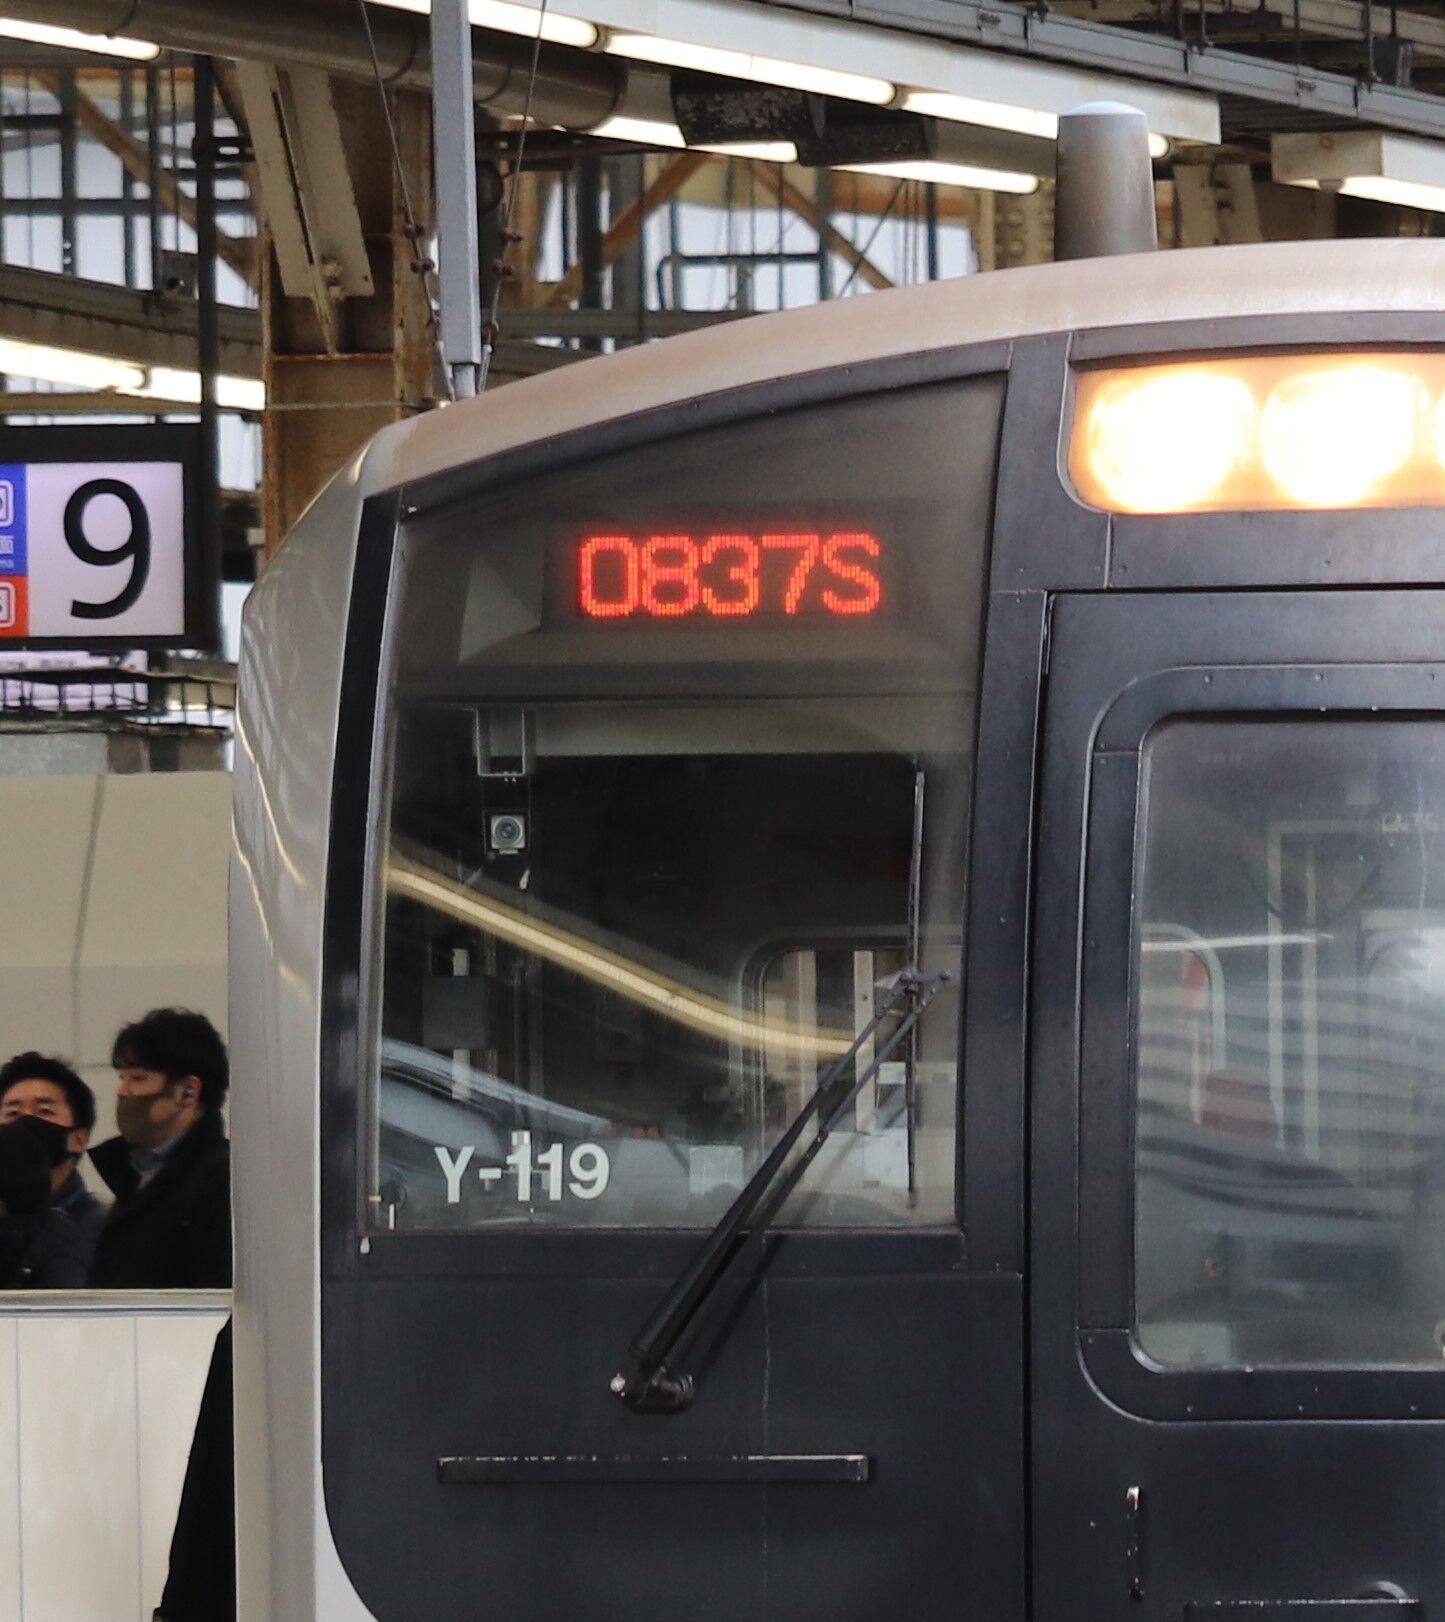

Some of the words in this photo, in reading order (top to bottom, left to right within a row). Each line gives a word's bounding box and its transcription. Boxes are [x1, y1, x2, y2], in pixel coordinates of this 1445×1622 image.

[62, 478, 151, 620] 9
[580, 532, 881, 617] 0837S
[434, 1142, 610, 1203] Y-119
